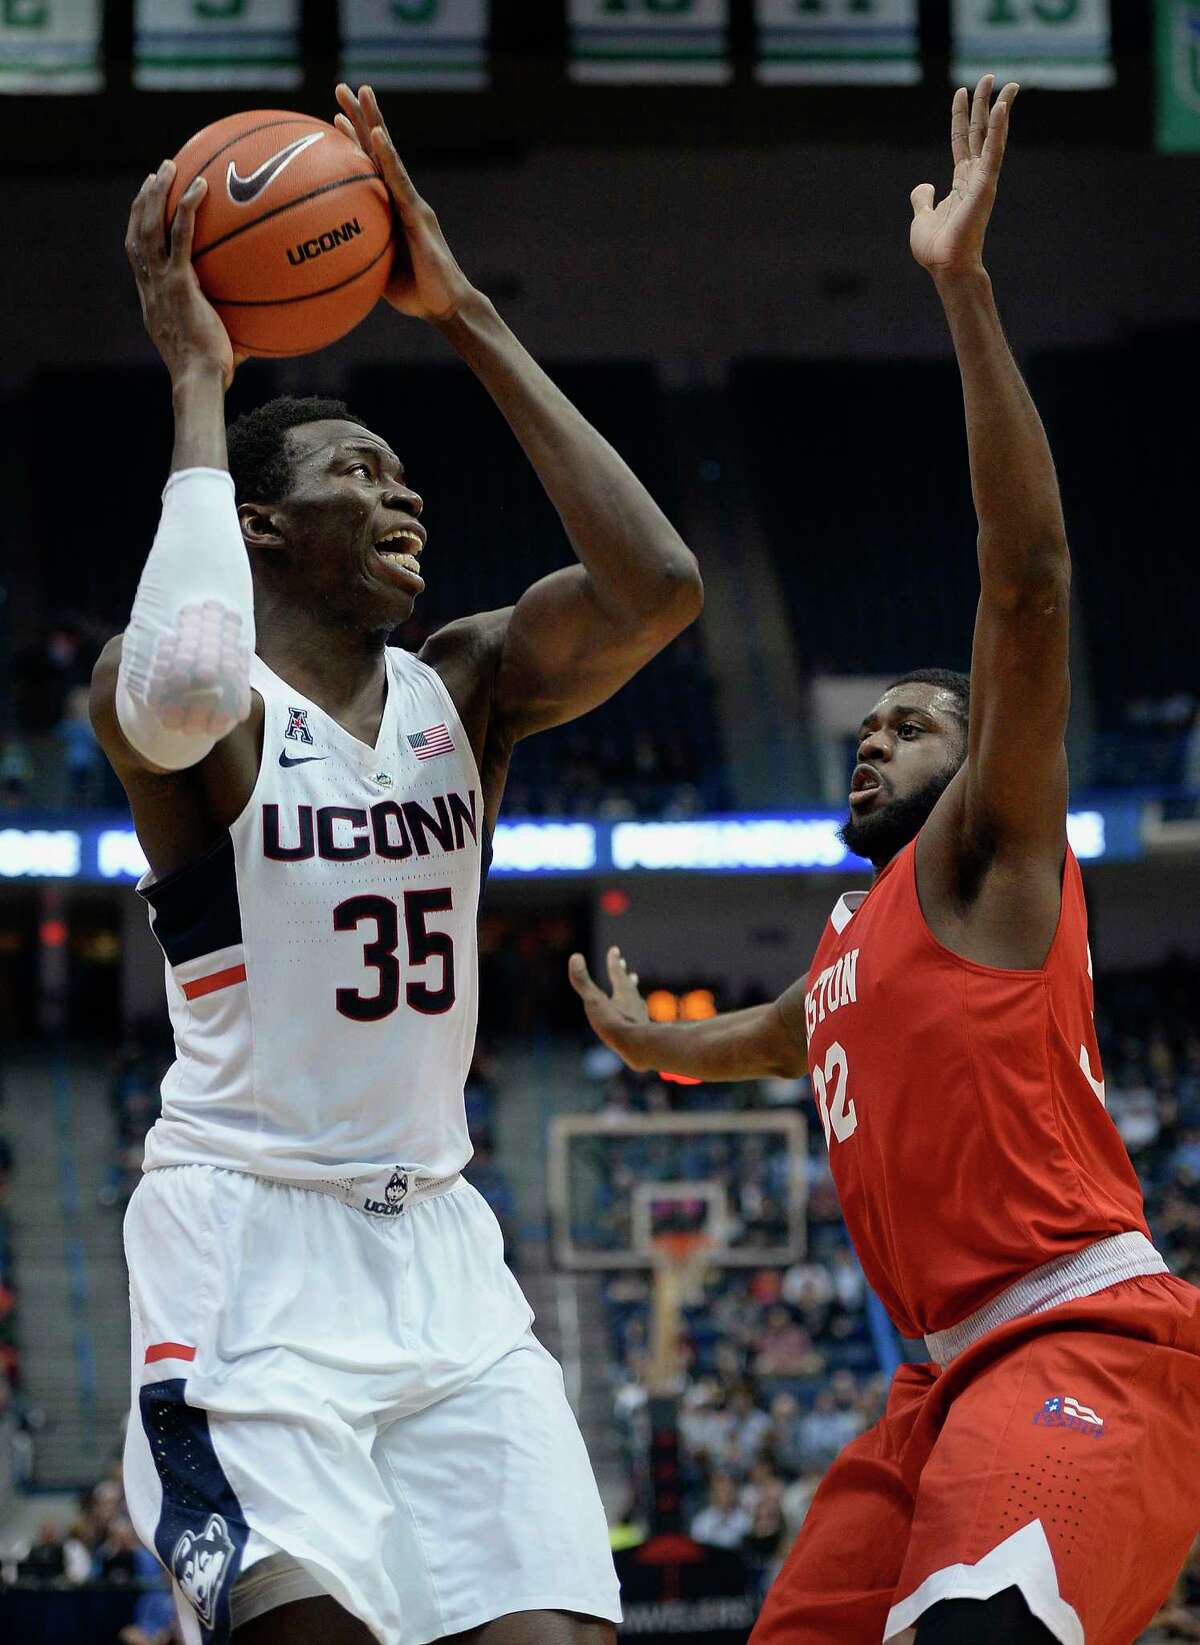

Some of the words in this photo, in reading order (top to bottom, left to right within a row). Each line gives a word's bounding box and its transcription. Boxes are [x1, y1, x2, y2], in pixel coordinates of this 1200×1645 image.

[286, 218, 362, 266] UCONN
[262, 790, 478, 862] UCONN
[333, 887, 456, 1022] 35
[804, 947, 860, 1050] STON
